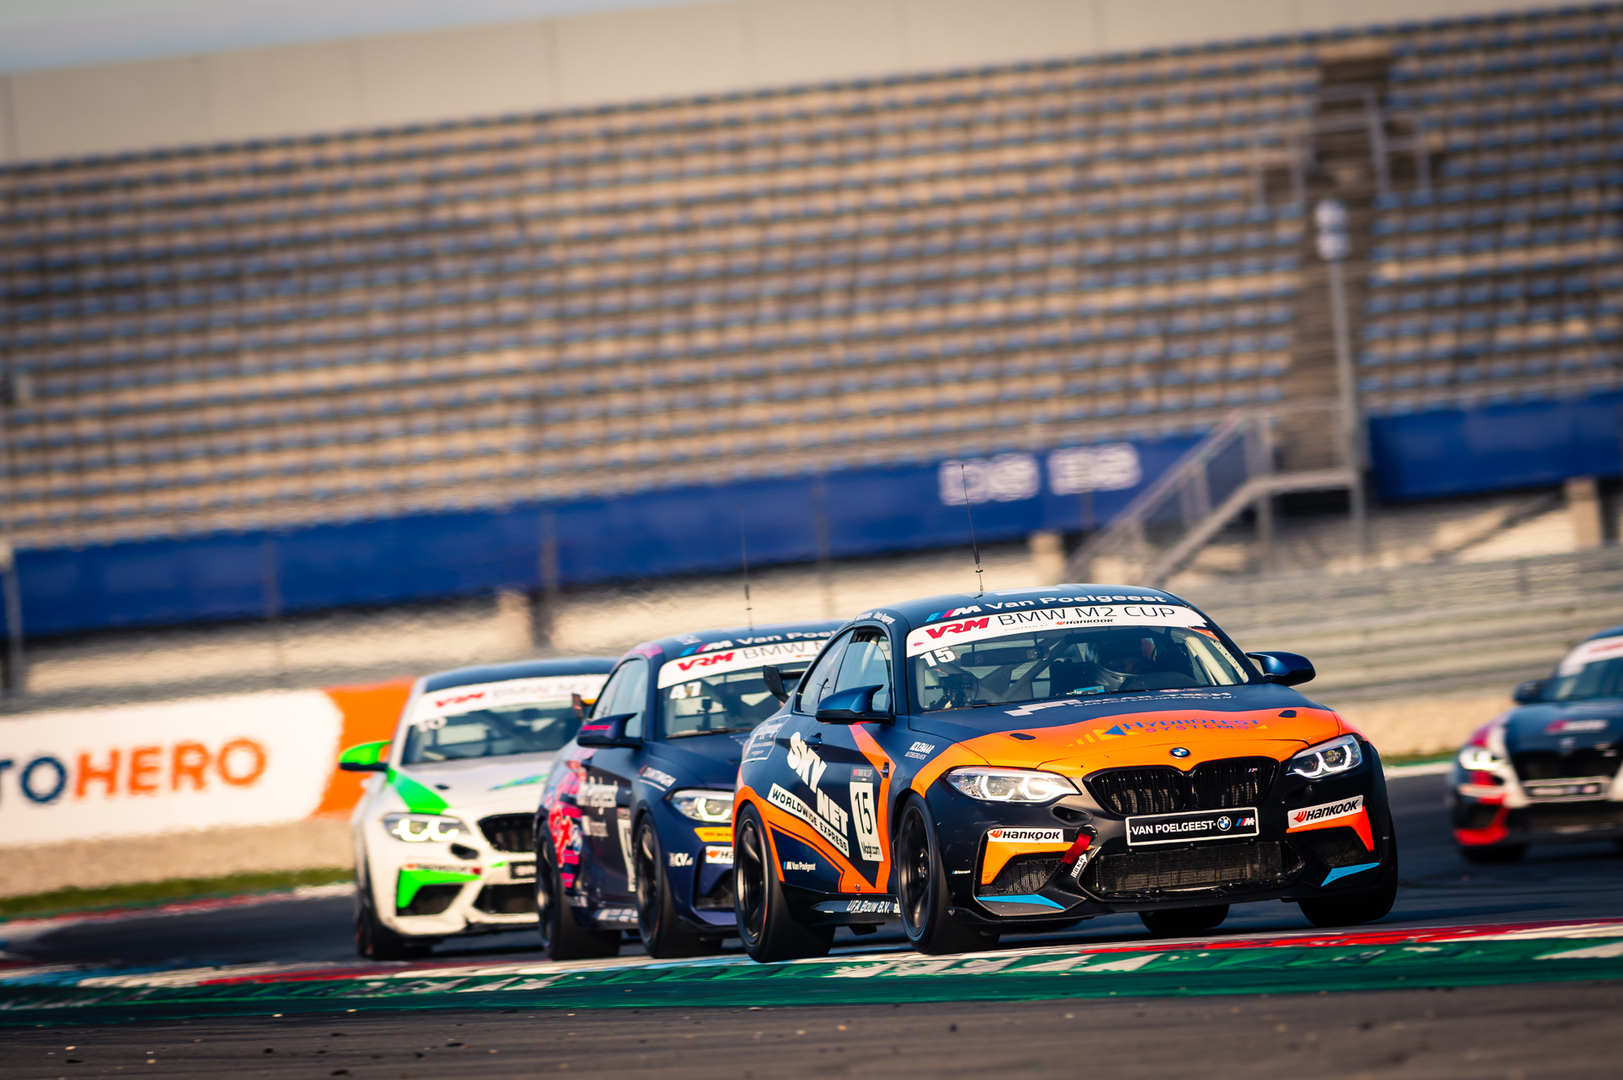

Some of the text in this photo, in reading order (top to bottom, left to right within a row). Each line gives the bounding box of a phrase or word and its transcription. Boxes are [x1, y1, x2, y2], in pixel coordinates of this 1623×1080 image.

[985, 600, 1035, 609] Van
[1039, 595, 1167, 604] Poelgeest
[926, 606, 1175, 639] VRM BMW M2 CUP
[736, 635, 782, 645] Van
[677, 652, 735, 671] VRM
[743, 642, 805, 660] BMW
[920, 647, 956, 668] 15
[669, 681, 702, 700] 47
[1145, 724, 1249, 733] SYSTEMS
[787, 731, 828, 794] SKY
[772, 788, 848, 852] WORLDWIDE EXPRESS
[816, 787, 849, 837] NET
[855, 791, 873, 835] 15
[1131, 825, 1154, 835] VAN
[1155, 820, 1215, 834] POELGEEST
